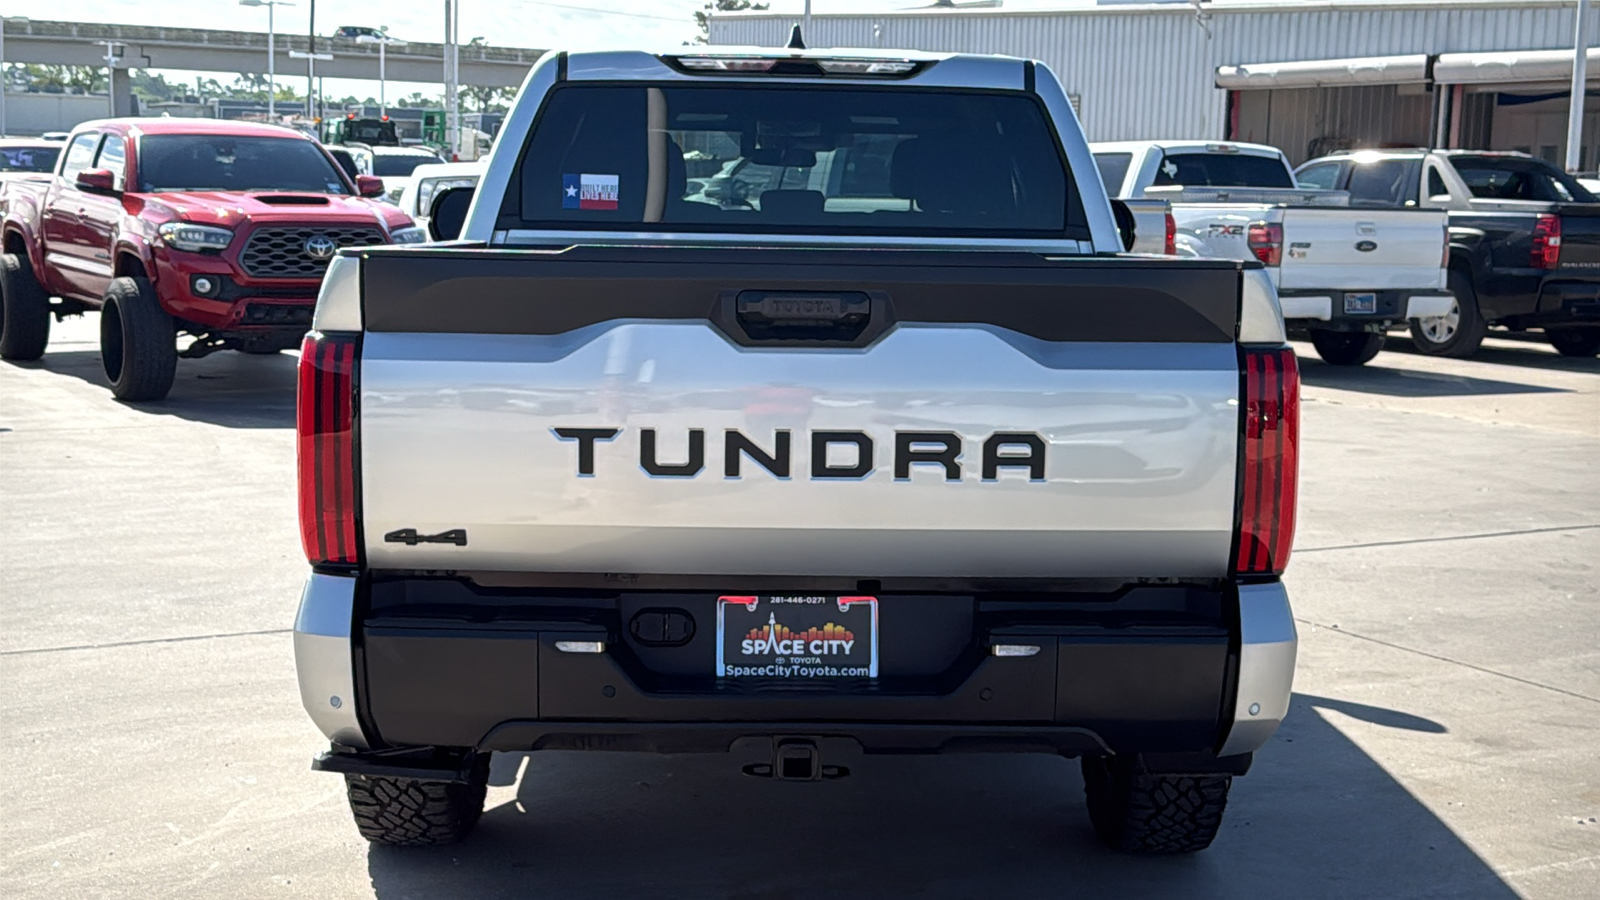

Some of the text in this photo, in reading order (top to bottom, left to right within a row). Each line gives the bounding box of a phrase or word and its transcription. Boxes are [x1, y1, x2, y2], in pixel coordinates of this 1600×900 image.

[581, 191, 619, 201] LIVES HERE
[1209, 224, 1244, 235] FX2
[771, 300, 835, 313] TOYOTA
[550, 427, 1048, 483] TUNDRA
[770, 596, 826, 604] 281-446-0271
[741, 639, 855, 655] SPACE CITY
[789, 657, 822, 665] TOYOTA
[726, 665, 869, 678] SpaceCityToyota.com
